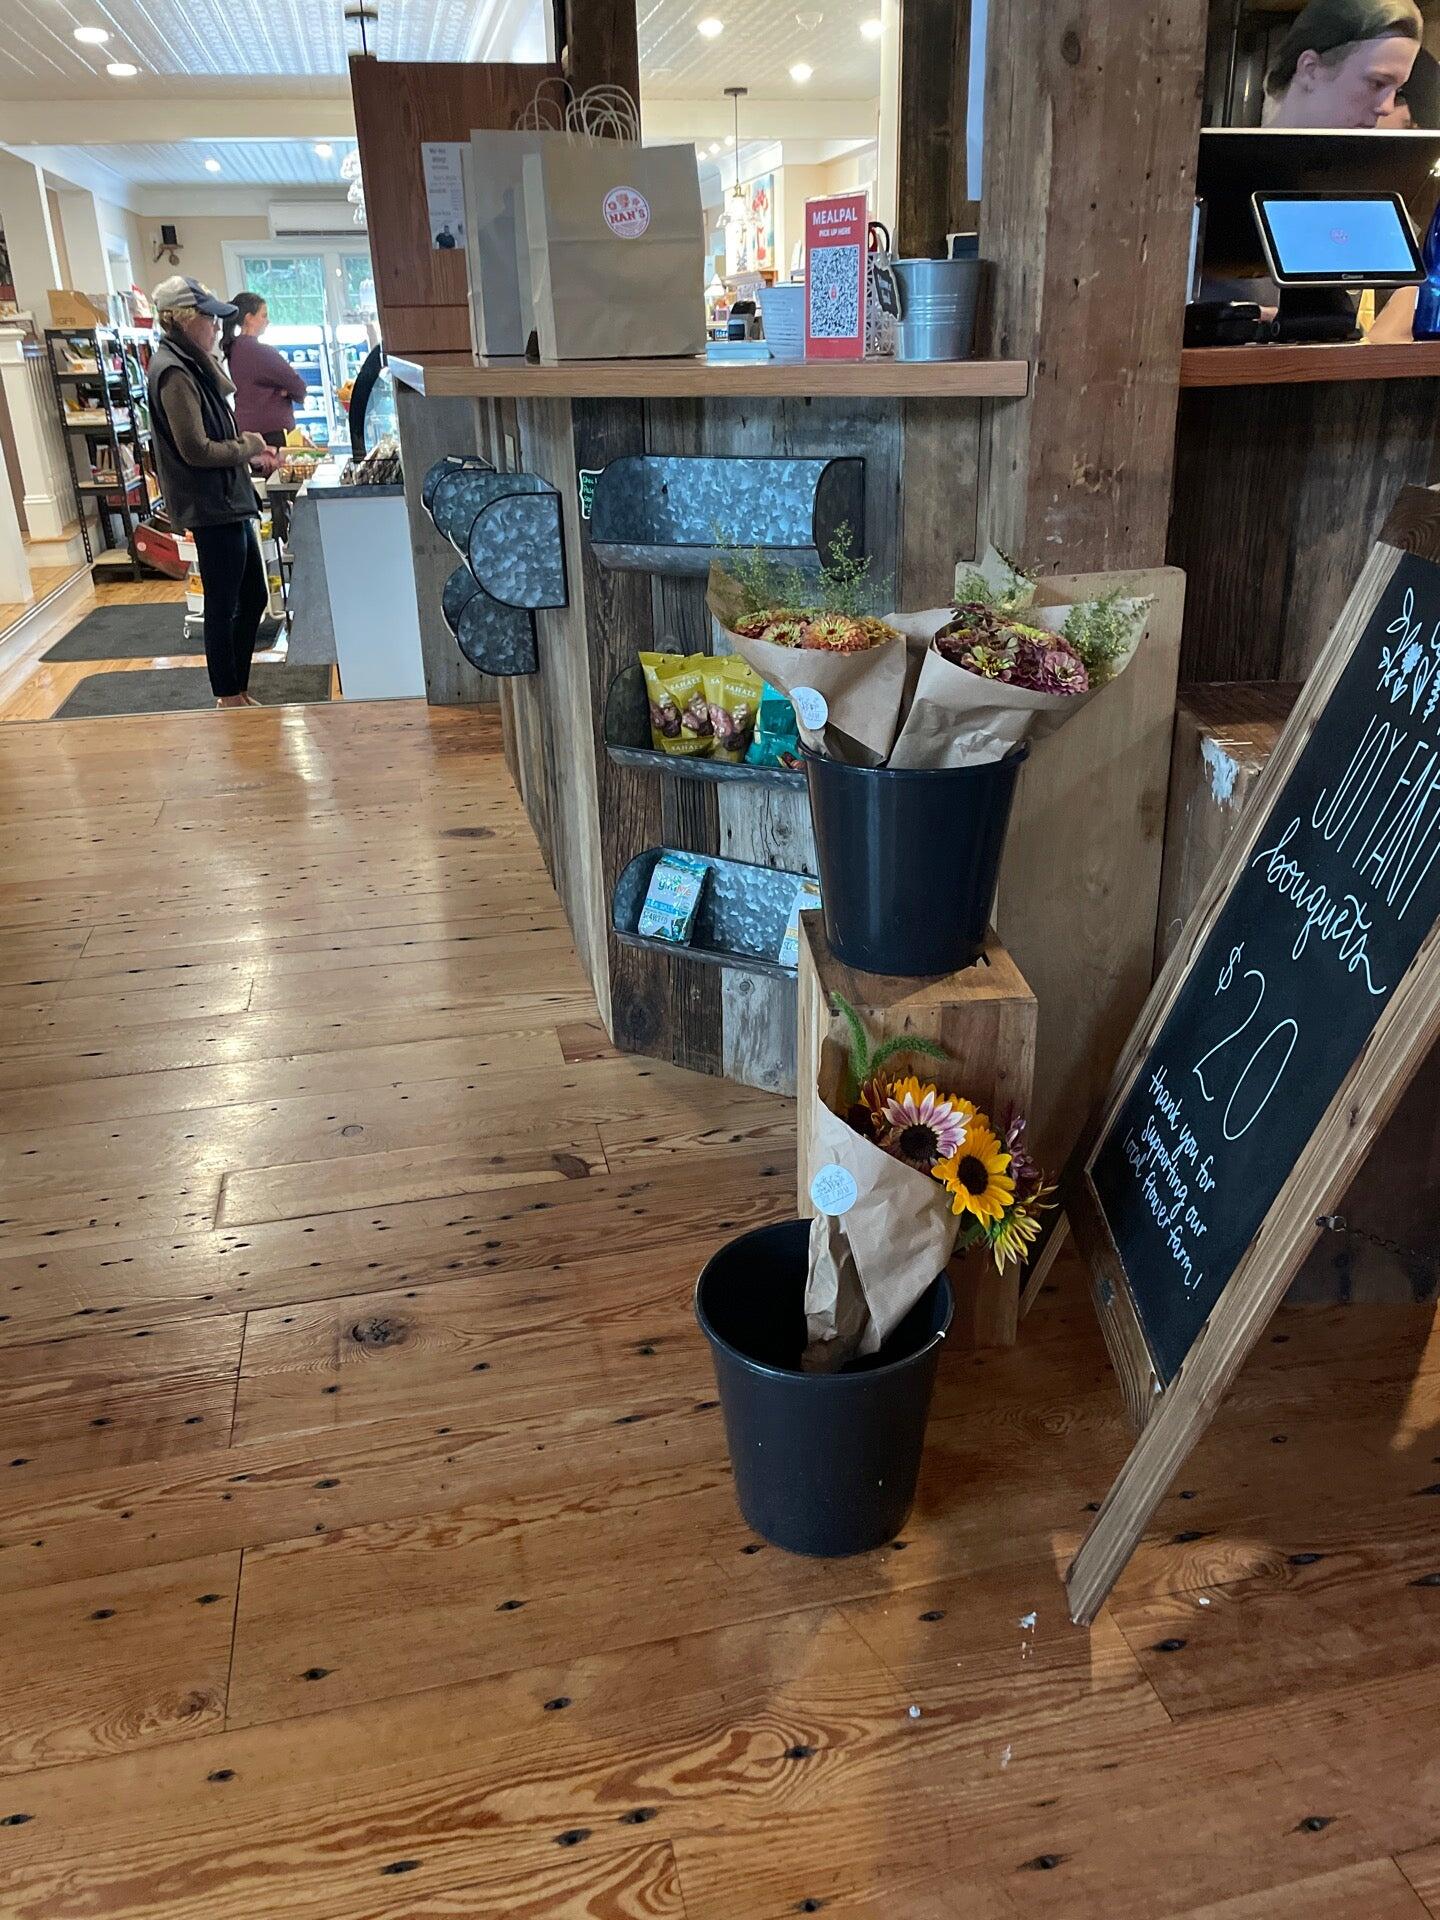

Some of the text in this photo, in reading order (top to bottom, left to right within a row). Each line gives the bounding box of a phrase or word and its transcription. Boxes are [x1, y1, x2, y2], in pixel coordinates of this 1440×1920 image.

[610, 207, 646, 224] NAN'S
[812, 206, 858, 226] MEALPAL
[1251, 816, 1388, 995] bouquets
[1171, 1123, 1199, 1167] you
[1195, 1155, 1215, 1193] for
[1141, 1171, 1171, 1229] flower
[1185, 1205, 1207, 1237] our
